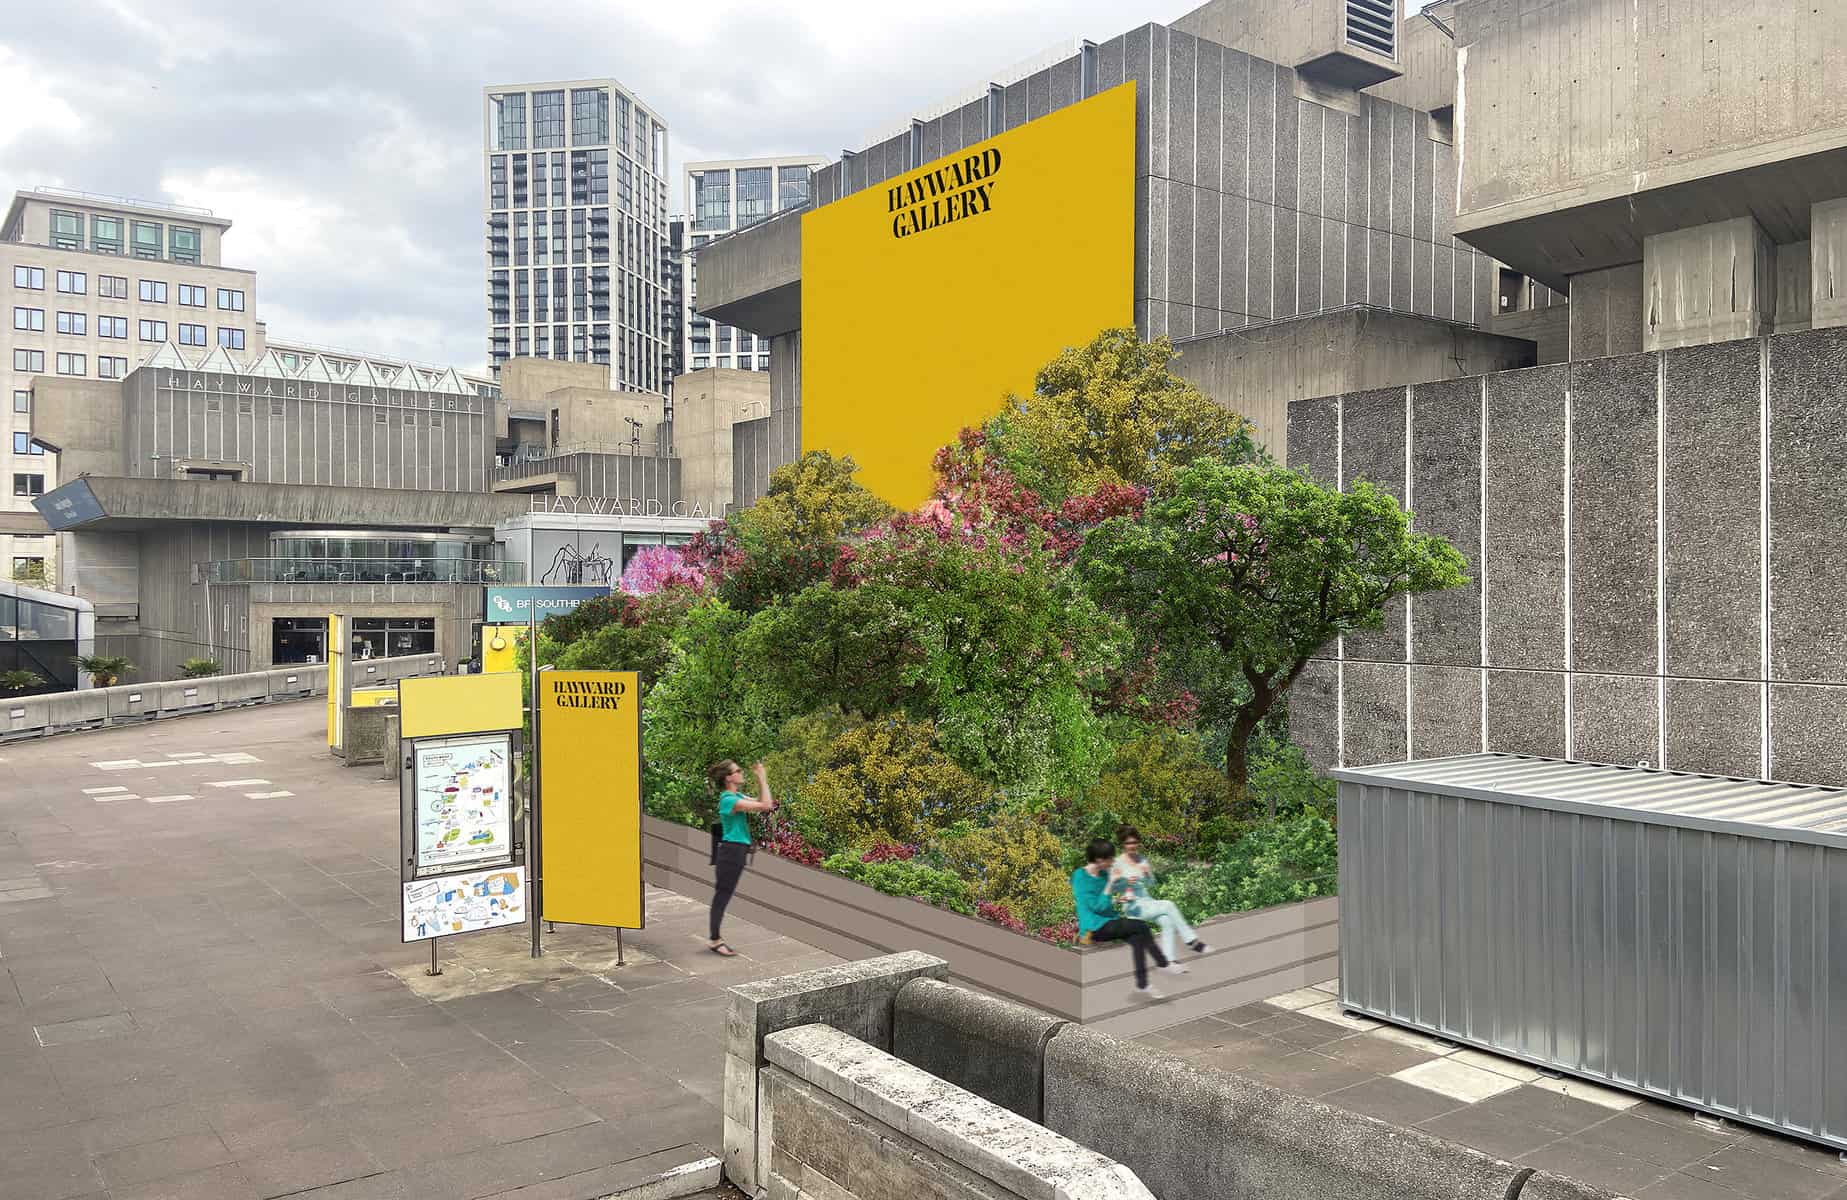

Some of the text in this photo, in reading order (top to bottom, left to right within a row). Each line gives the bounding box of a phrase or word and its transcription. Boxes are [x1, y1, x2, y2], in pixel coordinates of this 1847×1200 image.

[888, 148, 1001, 213] HAYWARD
[893, 182, 995, 239] GALLERY
[168, 376, 473, 411] HAYWARD GALLERY
[530, 494, 727, 520] HAYWARD GALL
[535, 599, 581, 609] SOUTHB
[553, 681, 626, 695] HAYWARD
[556, 694, 621, 710] GALLERY
